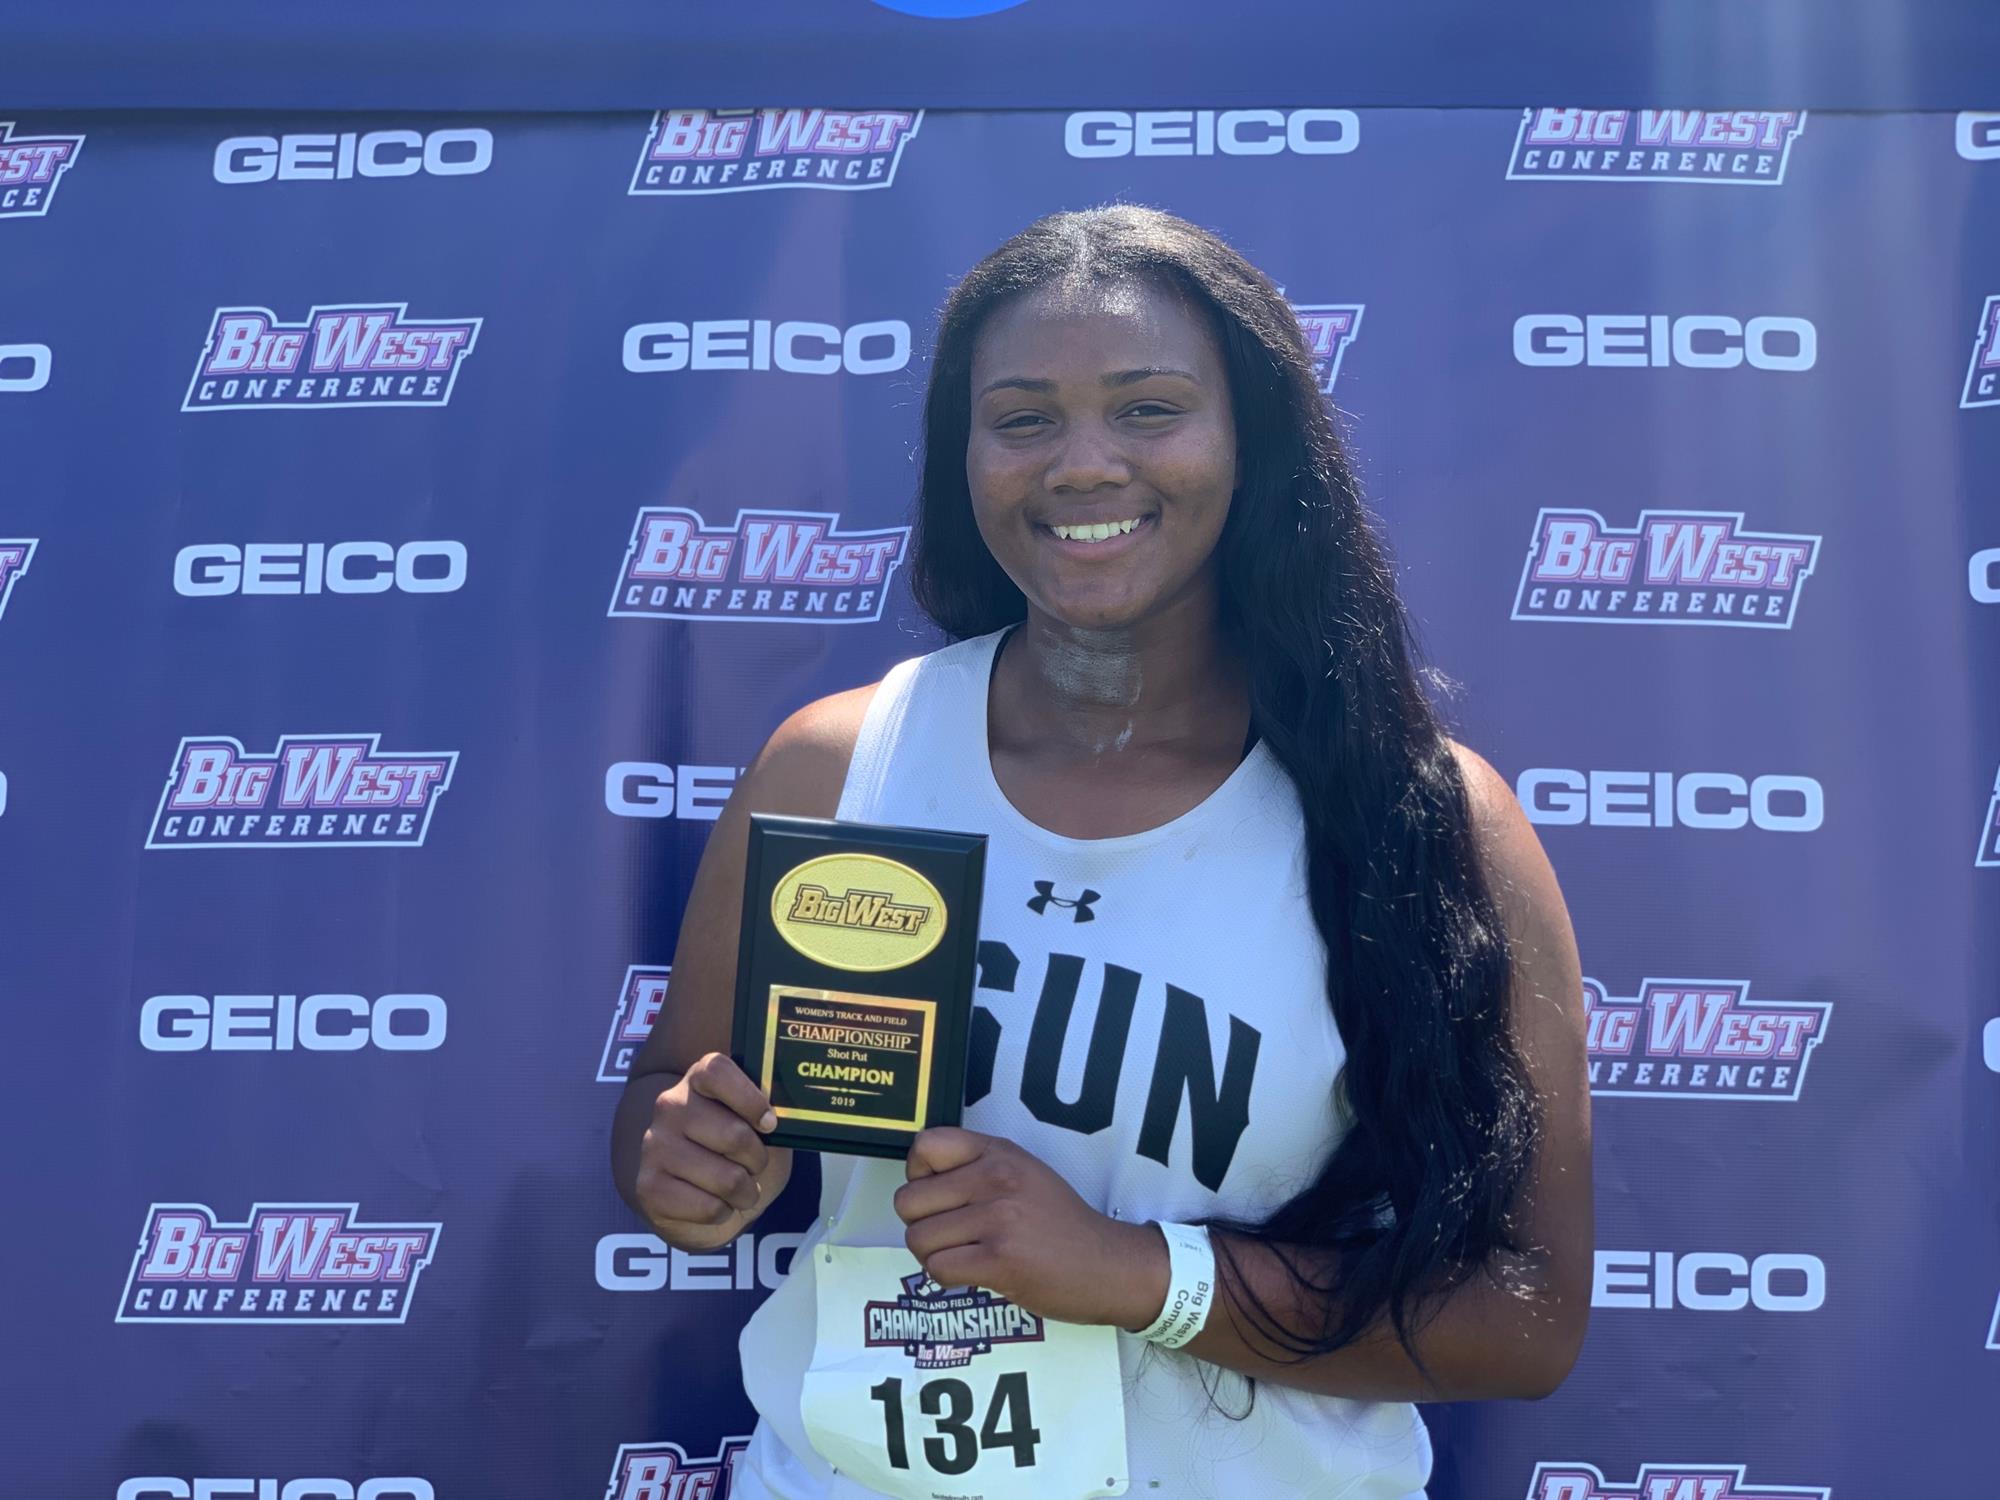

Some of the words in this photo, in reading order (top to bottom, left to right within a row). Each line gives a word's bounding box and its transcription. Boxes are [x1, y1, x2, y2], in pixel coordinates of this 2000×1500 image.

[1064, 109, 1360, 158] GEICO
[212, 127, 494, 184] GEICO
[1524, 150, 1773, 174] CONFERENCE
[646, 158, 885, 184] CONFERENCE
[622, 319, 911, 376] GEICO
[1513, 314, 1817, 372] GEICO
[199, 375, 442, 400] CONFERENCE
[173, 540, 467, 597] GEICO
[626, 585, 874, 612] CONFERENCE
[1529, 588, 1783, 617] CONFERENCE
[1517, 768, 1824, 832] GEICO
[164, 813, 415, 838] CONFERENCE
[140, 995, 447, 1051] GEICO
[795, 1006, 834, 1018] WOMEN'S
[836, 1011, 862, 1021] TRACK
[864, 1014, 882, 1023] AND
[883, 1016, 907, 1026] FIELD
[787, 1024, 911, 1049] CHAMPIONSHIP
[827, 1048, 849, 1060] Shot
[851, 1050, 868, 1062] Put
[797, 1062, 894, 1086] CHAMPION
[831, 1096, 855, 1107] 2019
[134, 1288, 398, 1311] CONFERENCE
[929, 1301, 948, 1311] AND
[950, 1297, 974, 1308] FIELD
[1191, 1280, 1209, 1306] Big
[869, 1304, 1037, 1341] CHAMPIONSHIPS
[1176, 1310, 1201, 1338] West
[870, 1371, 1041, 1475] 134
